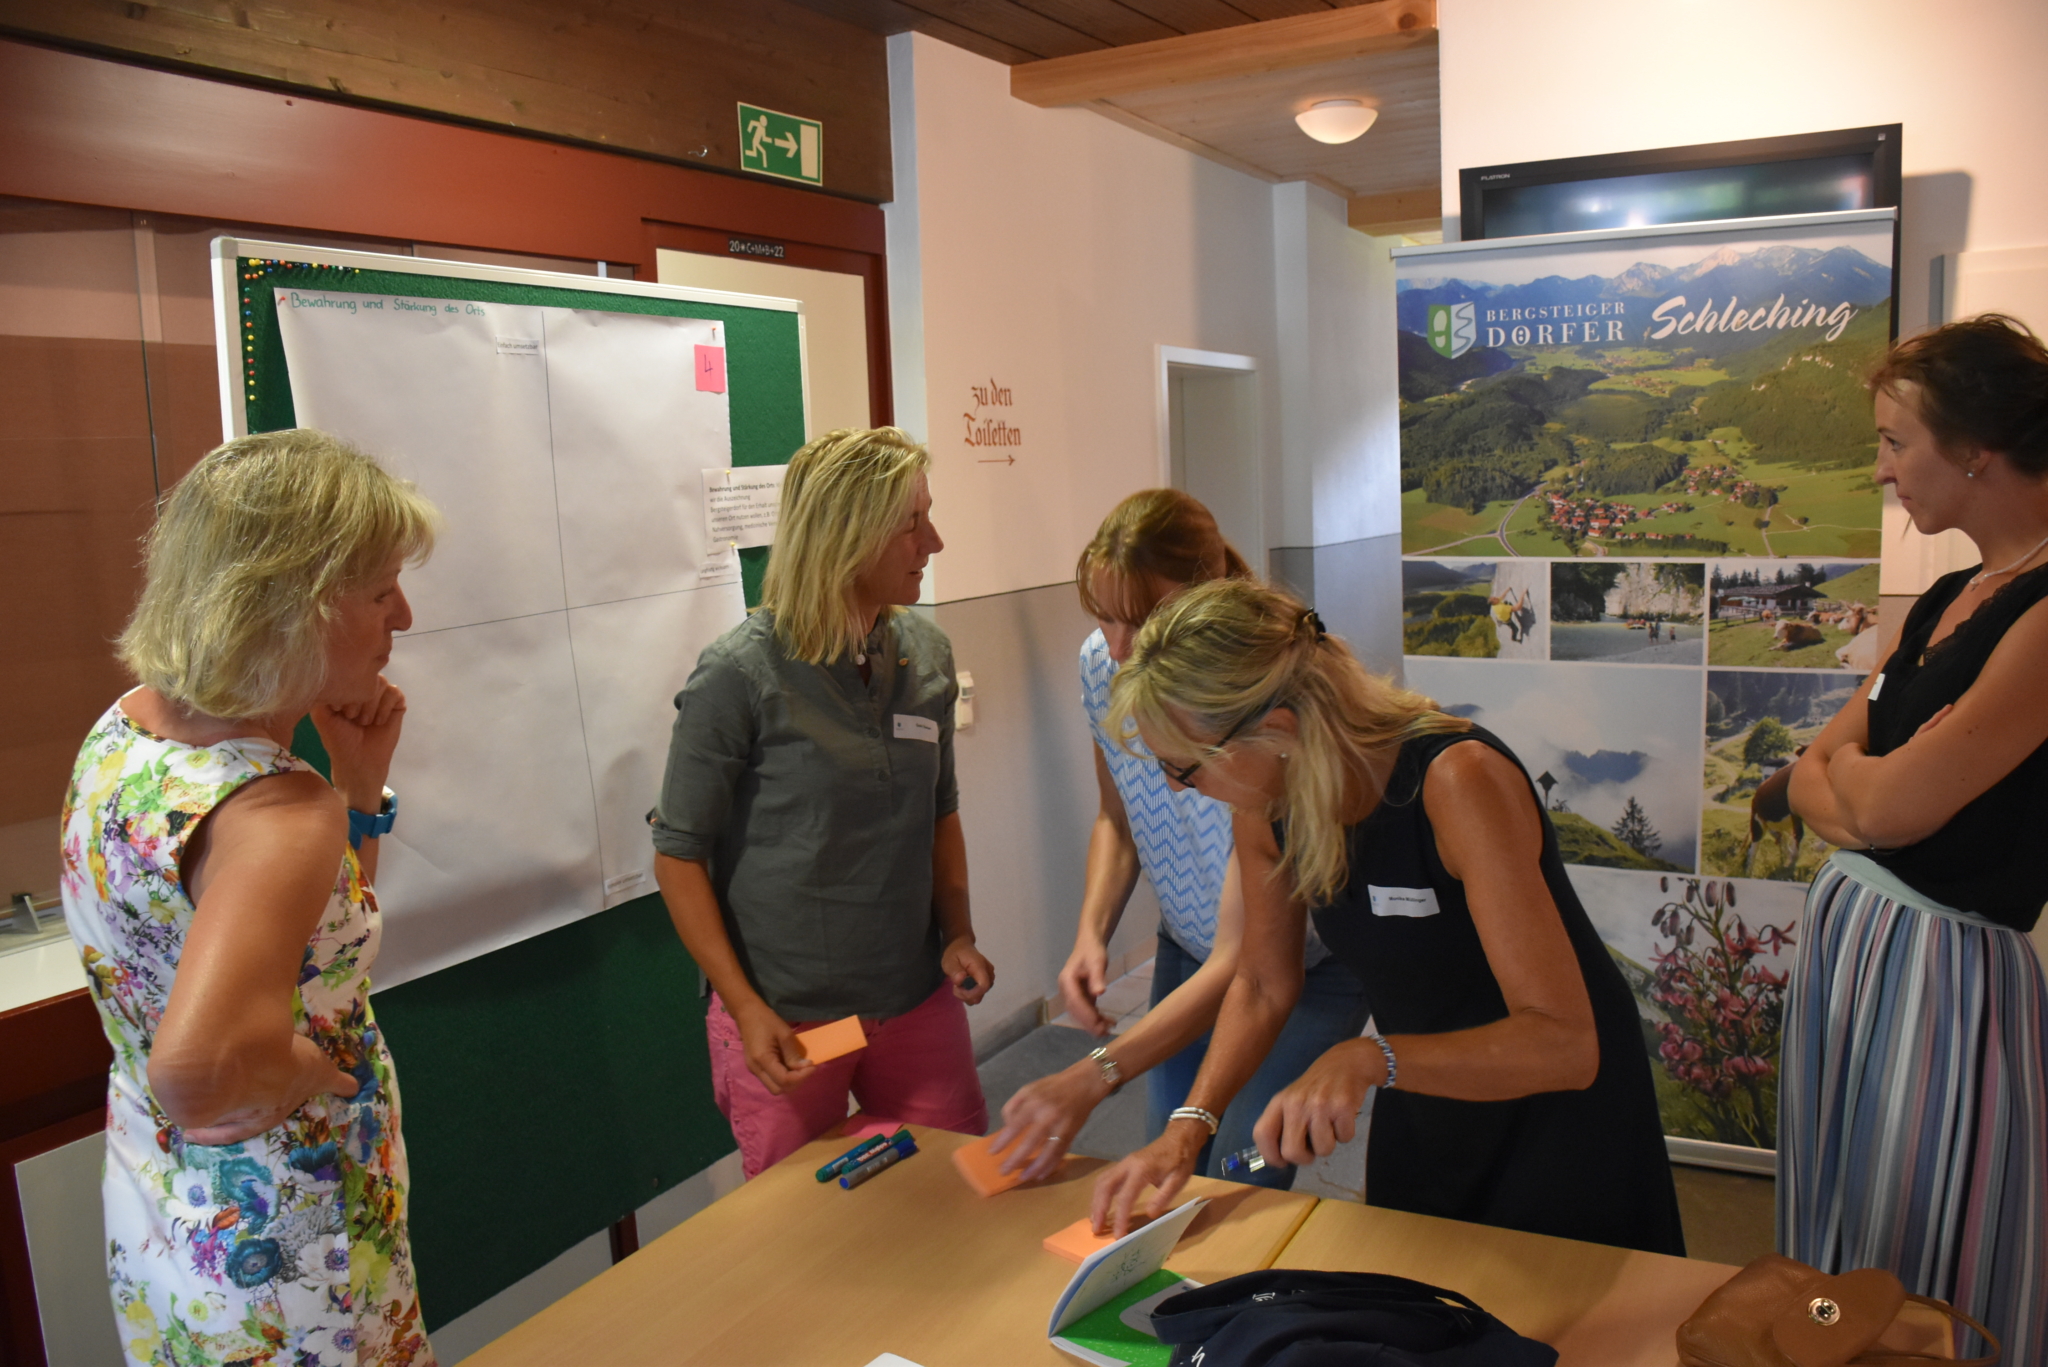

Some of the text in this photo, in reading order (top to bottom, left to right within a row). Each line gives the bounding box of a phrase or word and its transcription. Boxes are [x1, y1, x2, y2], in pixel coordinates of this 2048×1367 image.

[290, 291, 486, 317] Bewahrung und Stärkung des Orts
[1486, 301, 1625, 322] BERGSTEIGER
[1650, 292, 1859, 342] Schleching
[704, 353, 714, 379] 4
[971, 377, 1013, 417] zu den
